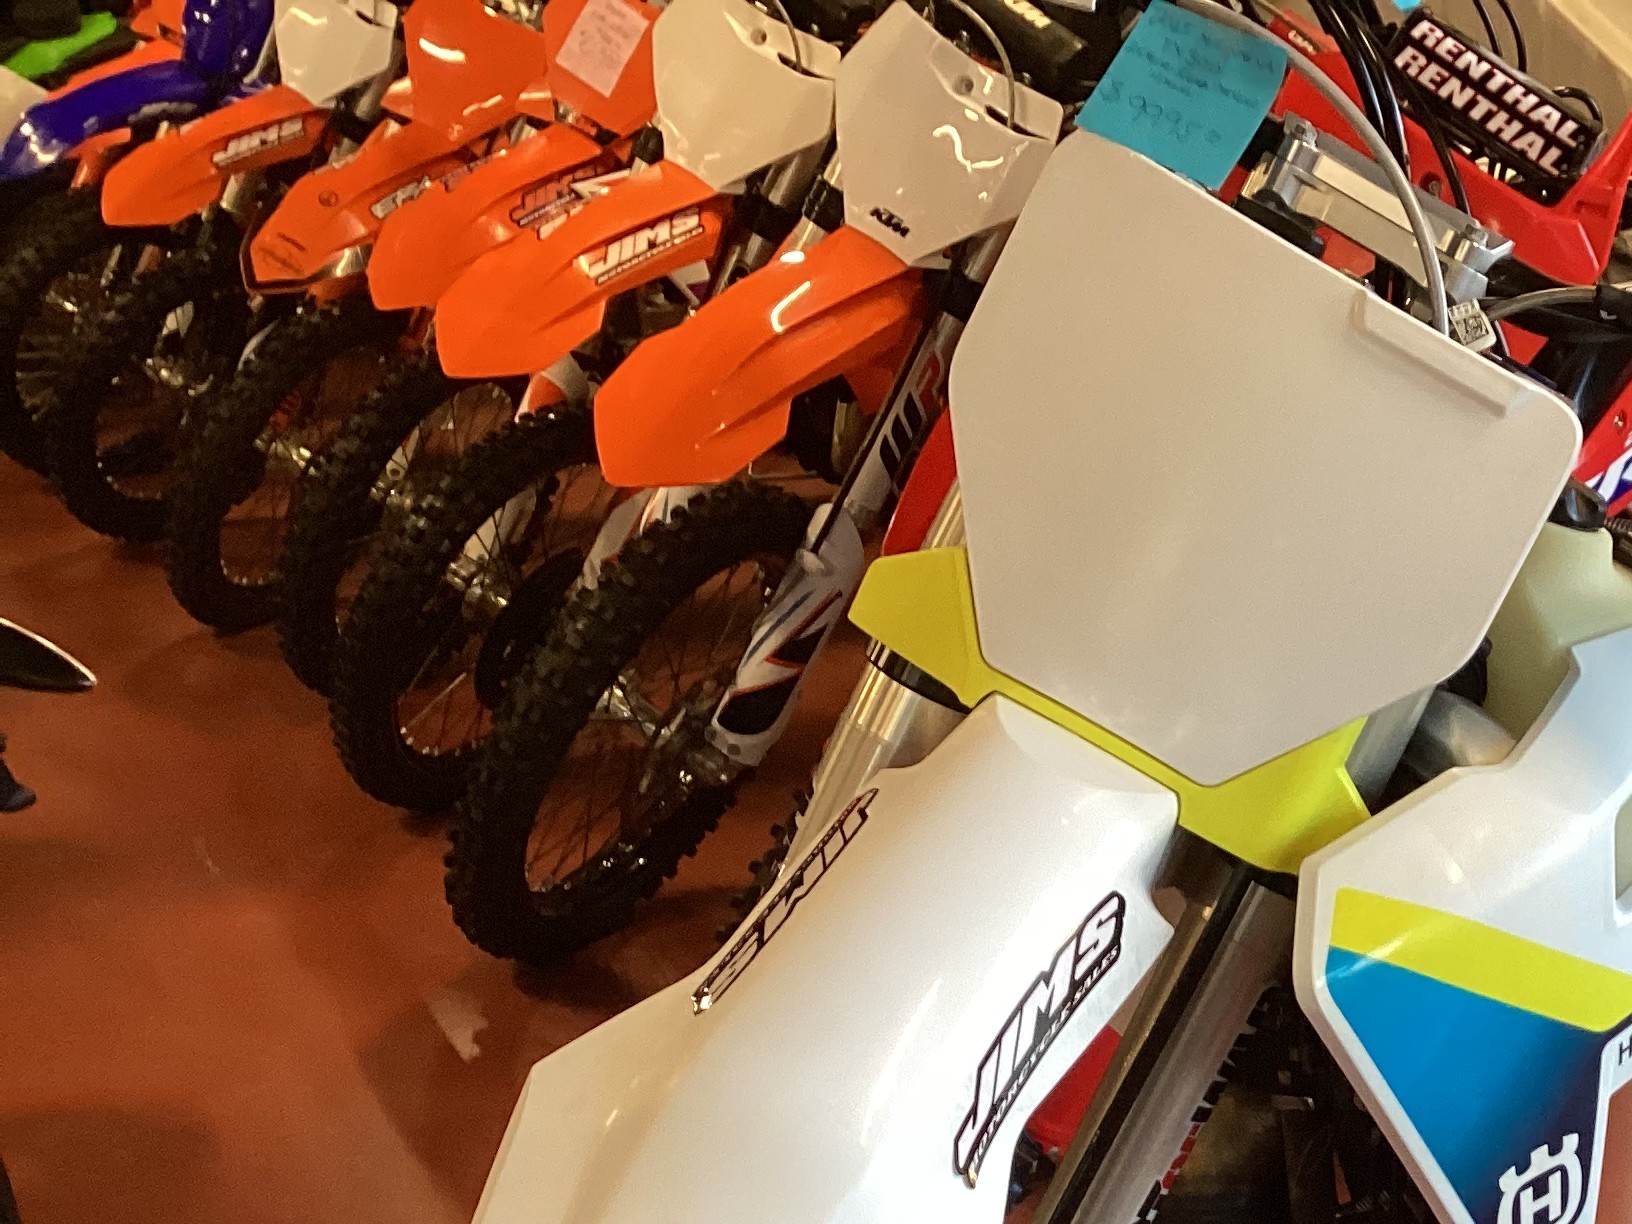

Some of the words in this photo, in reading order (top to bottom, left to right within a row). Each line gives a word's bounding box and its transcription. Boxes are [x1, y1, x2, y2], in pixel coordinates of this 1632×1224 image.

[1394, 45, 1563, 177] RENTHAL
[1410, 20, 1580, 148] RENTHAL
[588, 213, 700, 279] JIMS
[869, 206, 911, 238] KTM
[955, 891, 1124, 1174] JIMS
